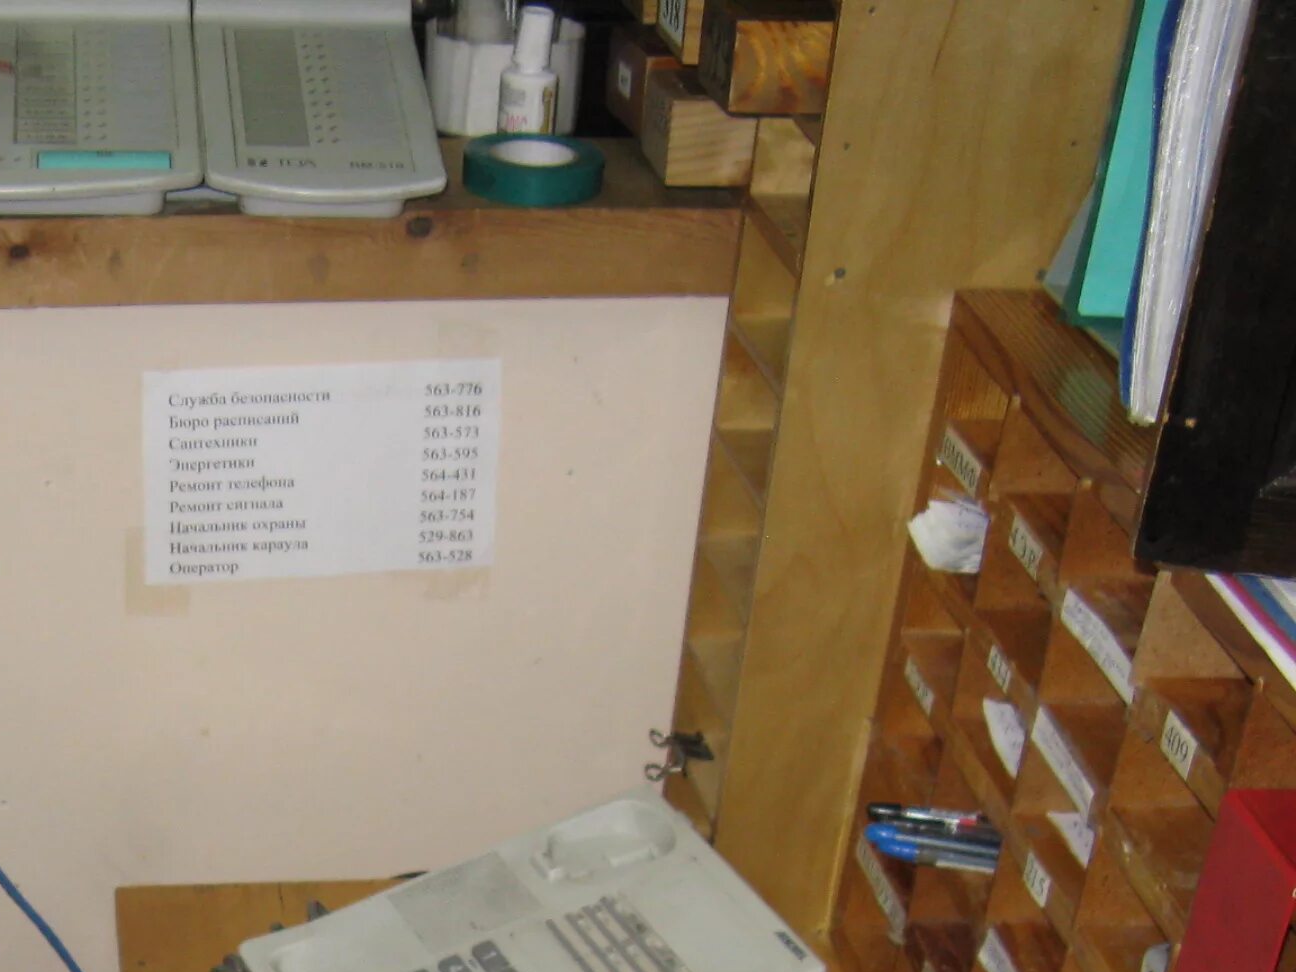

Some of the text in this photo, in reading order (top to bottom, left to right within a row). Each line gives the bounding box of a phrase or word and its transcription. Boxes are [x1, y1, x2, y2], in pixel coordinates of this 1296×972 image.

[168, 382, 482, 410] Служба безопасности 563-776
[169, 404, 481, 430] Бюро расписаний 563-816
[169, 426, 479, 450] Сантехники 563-573
[170, 447, 478, 473] Энергетики 563-595
[170, 468, 476, 493] Ремонт телефона 564-431
[170, 488, 476, 513] Ремонт сигнала 564-187
[170, 509, 474, 534] Начальник охраны 563-754
[170, 529, 473, 555] Начальник караула 529-863
[170, 550, 473, 576] Оператор 563-528
[1163, 723, 1191, 764] 409
